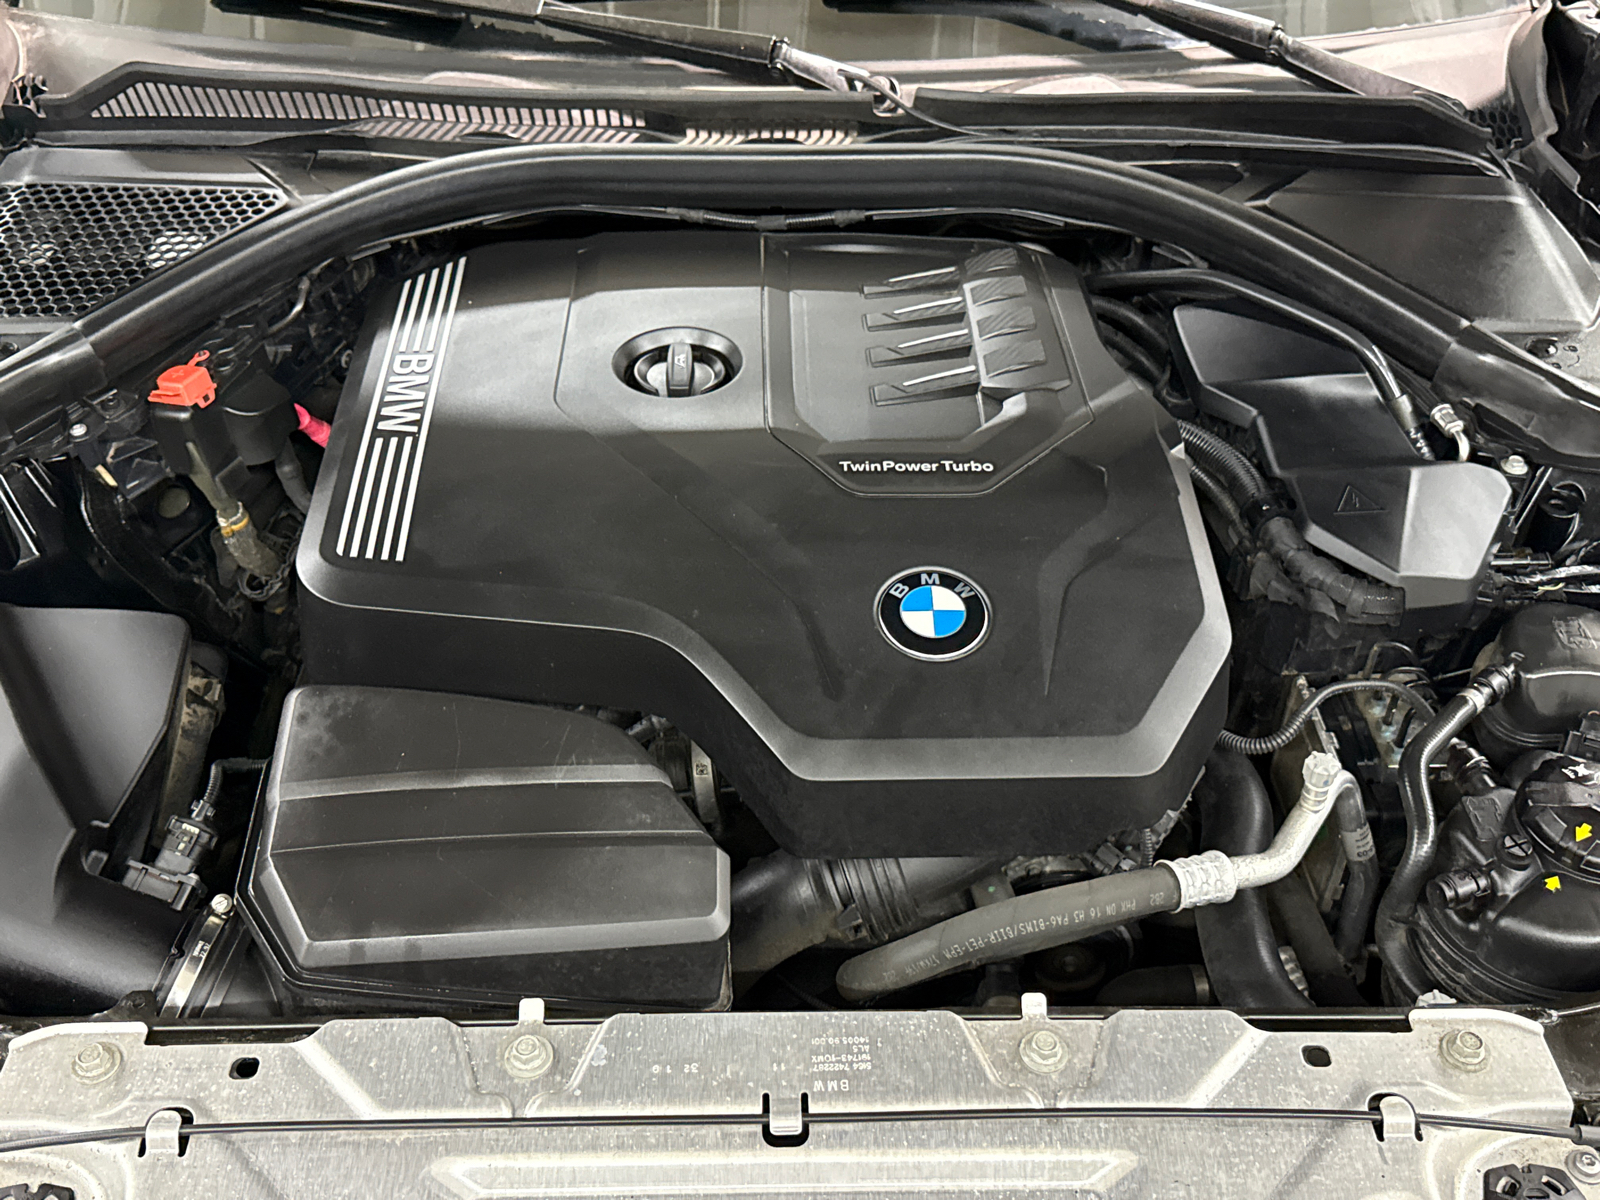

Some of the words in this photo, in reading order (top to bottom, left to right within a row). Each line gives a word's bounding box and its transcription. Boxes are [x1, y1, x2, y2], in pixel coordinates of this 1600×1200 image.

[377, 354, 435, 433] BMW
[940, 460, 994, 472] Turbo
[889, 573, 975, 599] BMW
[1090, 907, 1101, 918] 16
[1121, 900, 1137, 912] PHX
[1073, 910, 1085, 923] H3
[812, 1079, 850, 1092] BMW
